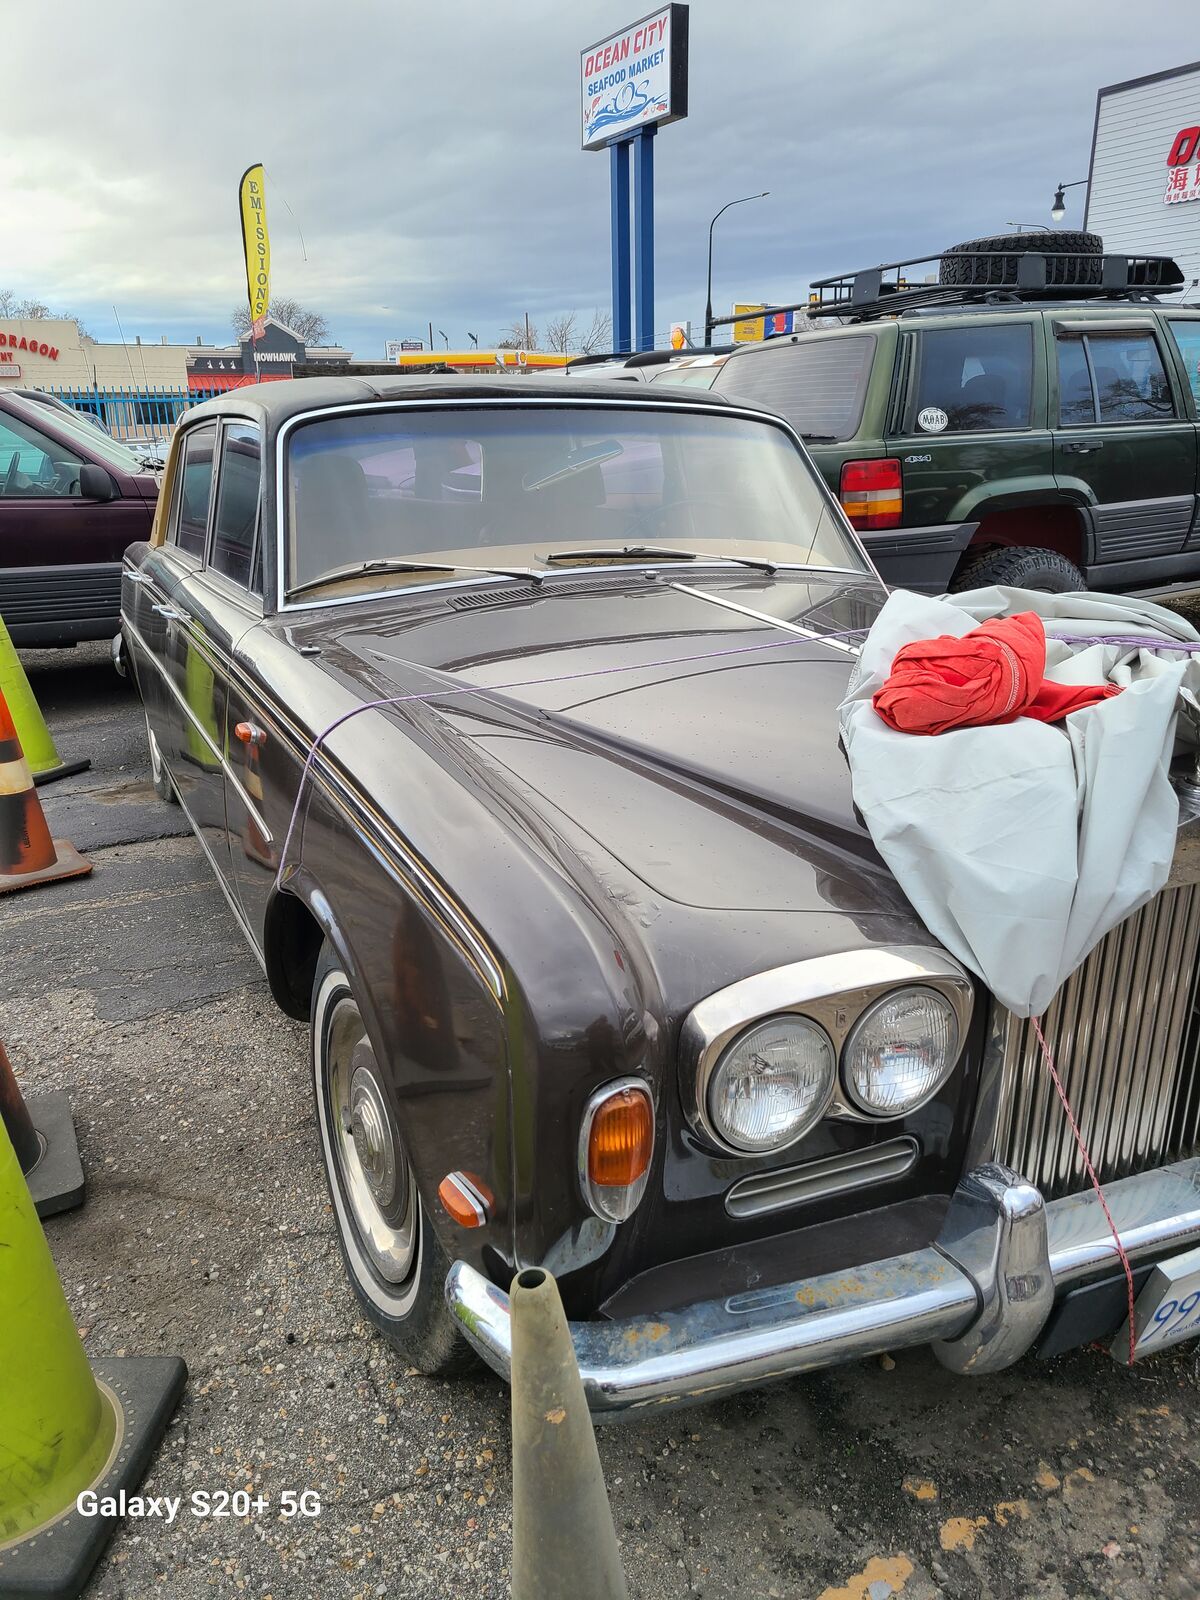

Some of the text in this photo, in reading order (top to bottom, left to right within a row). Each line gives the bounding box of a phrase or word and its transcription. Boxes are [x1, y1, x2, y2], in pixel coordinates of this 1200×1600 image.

[585, 16, 667, 77] OCEAN CITY
[588, 48, 665, 97] SEAFOOD MARKET
[1167, 126, 1200, 166] O
[248, 181, 267, 315] EMISSIONS
[0, 333, 59, 361] DRAGON
[253, 352, 297, 362] MOWHAWK
[922, 414, 945, 425] MOAB
[1141, 1290, 1200, 1343] 99
